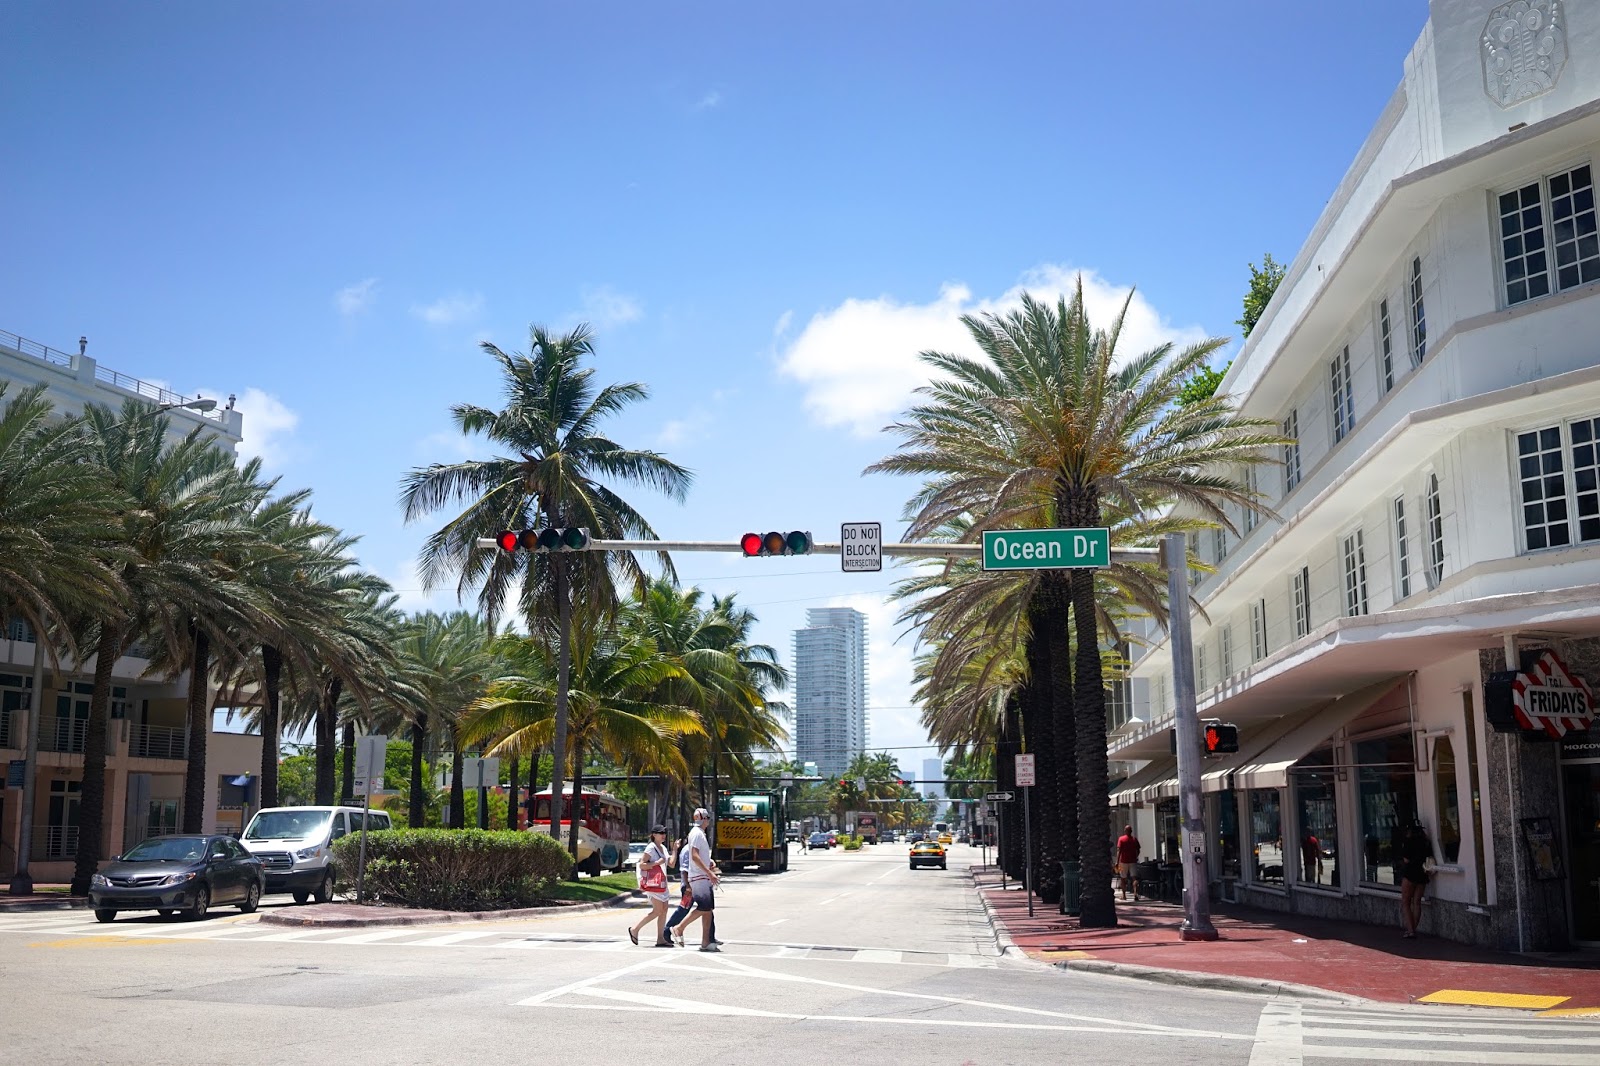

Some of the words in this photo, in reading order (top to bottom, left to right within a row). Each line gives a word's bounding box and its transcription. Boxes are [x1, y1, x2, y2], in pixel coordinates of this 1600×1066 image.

[844, 528, 857, 540] DO
[860, 527, 879, 540] NOT
[846, 544, 877, 556] BLOCK
[993, 537, 1062, 561] Ocean
[1073, 535, 1098, 558] Dr
[844, 558, 880, 568] INTERSECTION
